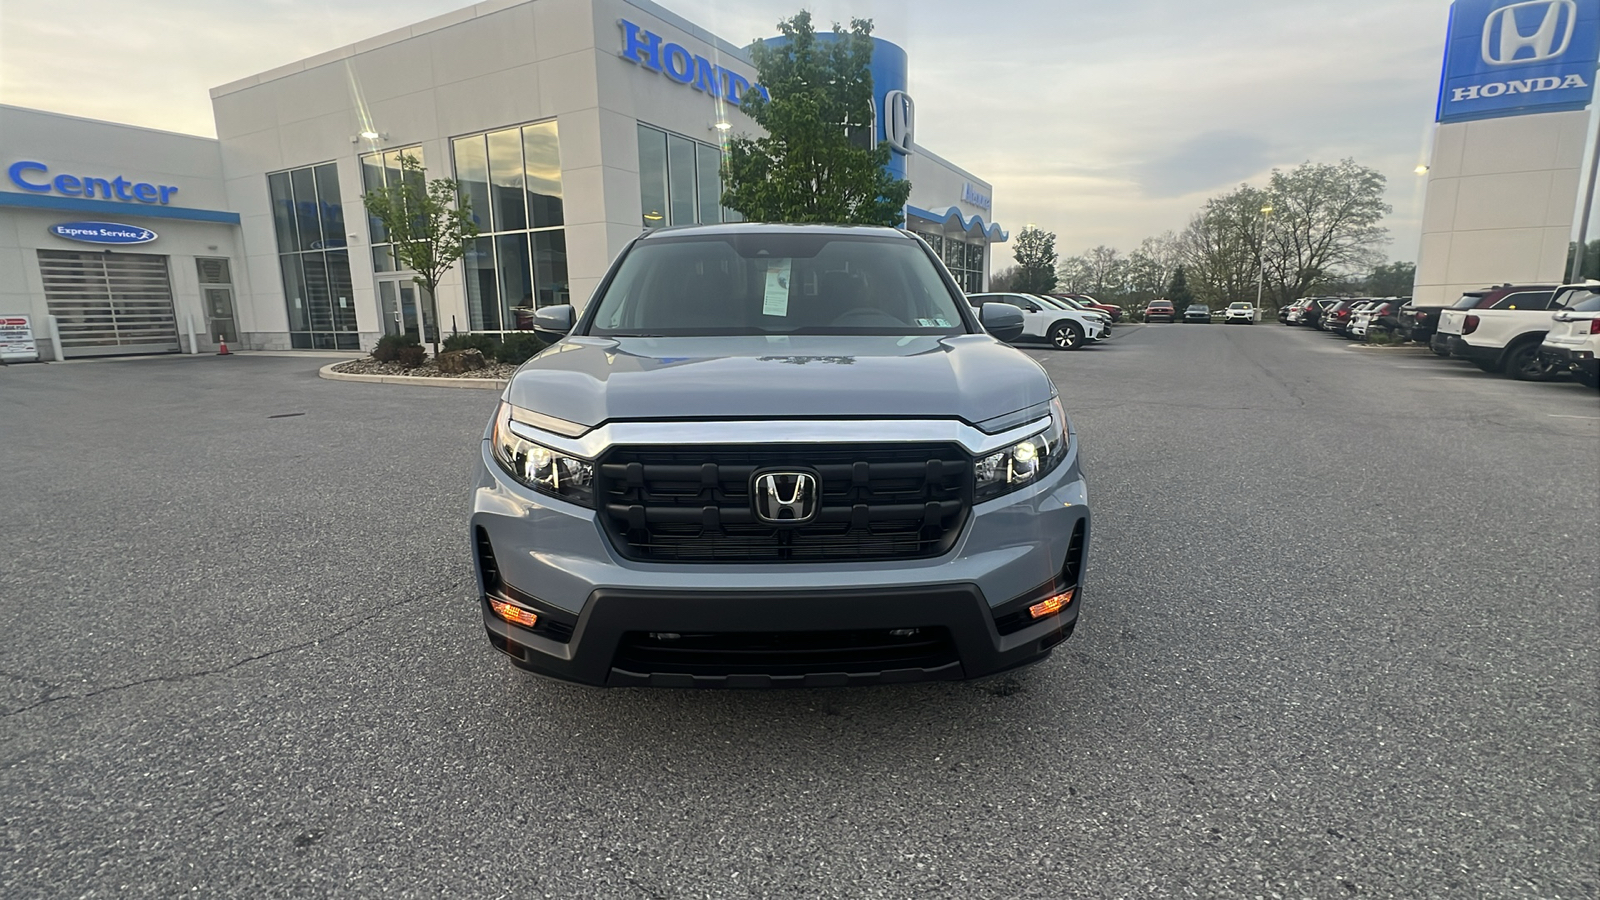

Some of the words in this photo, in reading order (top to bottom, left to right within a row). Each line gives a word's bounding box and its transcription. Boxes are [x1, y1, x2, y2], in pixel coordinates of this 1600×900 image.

[1451, 74, 1588, 101] HONDA
[8, 161, 178, 204] Center
[57, 226, 98, 236] Express
[99, 229, 137, 239] Service
